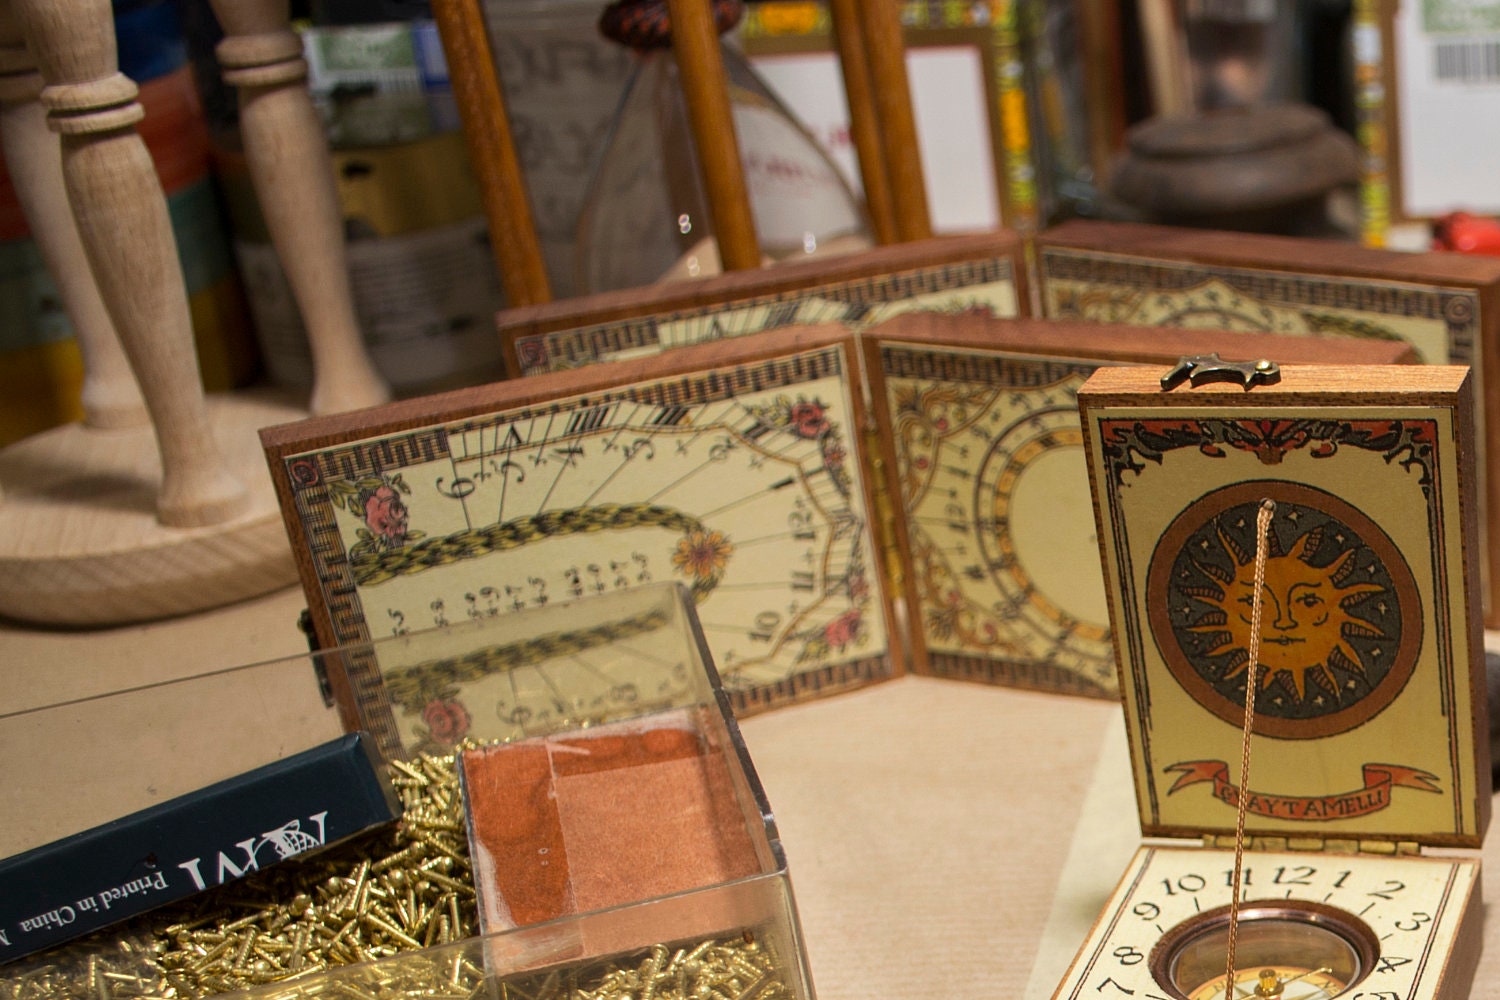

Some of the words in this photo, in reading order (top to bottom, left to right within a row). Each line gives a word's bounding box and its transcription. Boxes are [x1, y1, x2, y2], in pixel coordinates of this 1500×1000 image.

[1161, 874, 1206, 896] 10
[1273, 866, 1318, 886] 12
[1333, 870, 1354, 889] 1
[99, 871, 169, 910] Printed
[1367, 880, 1406, 900] 2
[76, 897, 99, 912] in
[1133, 902, 1161, 921] 9
[20, 906, 76, 932] China
[1394, 911, 1432, 934] 3
[1113, 946, 1145, 966] 8
[1376, 955, 1413, 975] 4
[1096, 977, 1136, 996] 7
